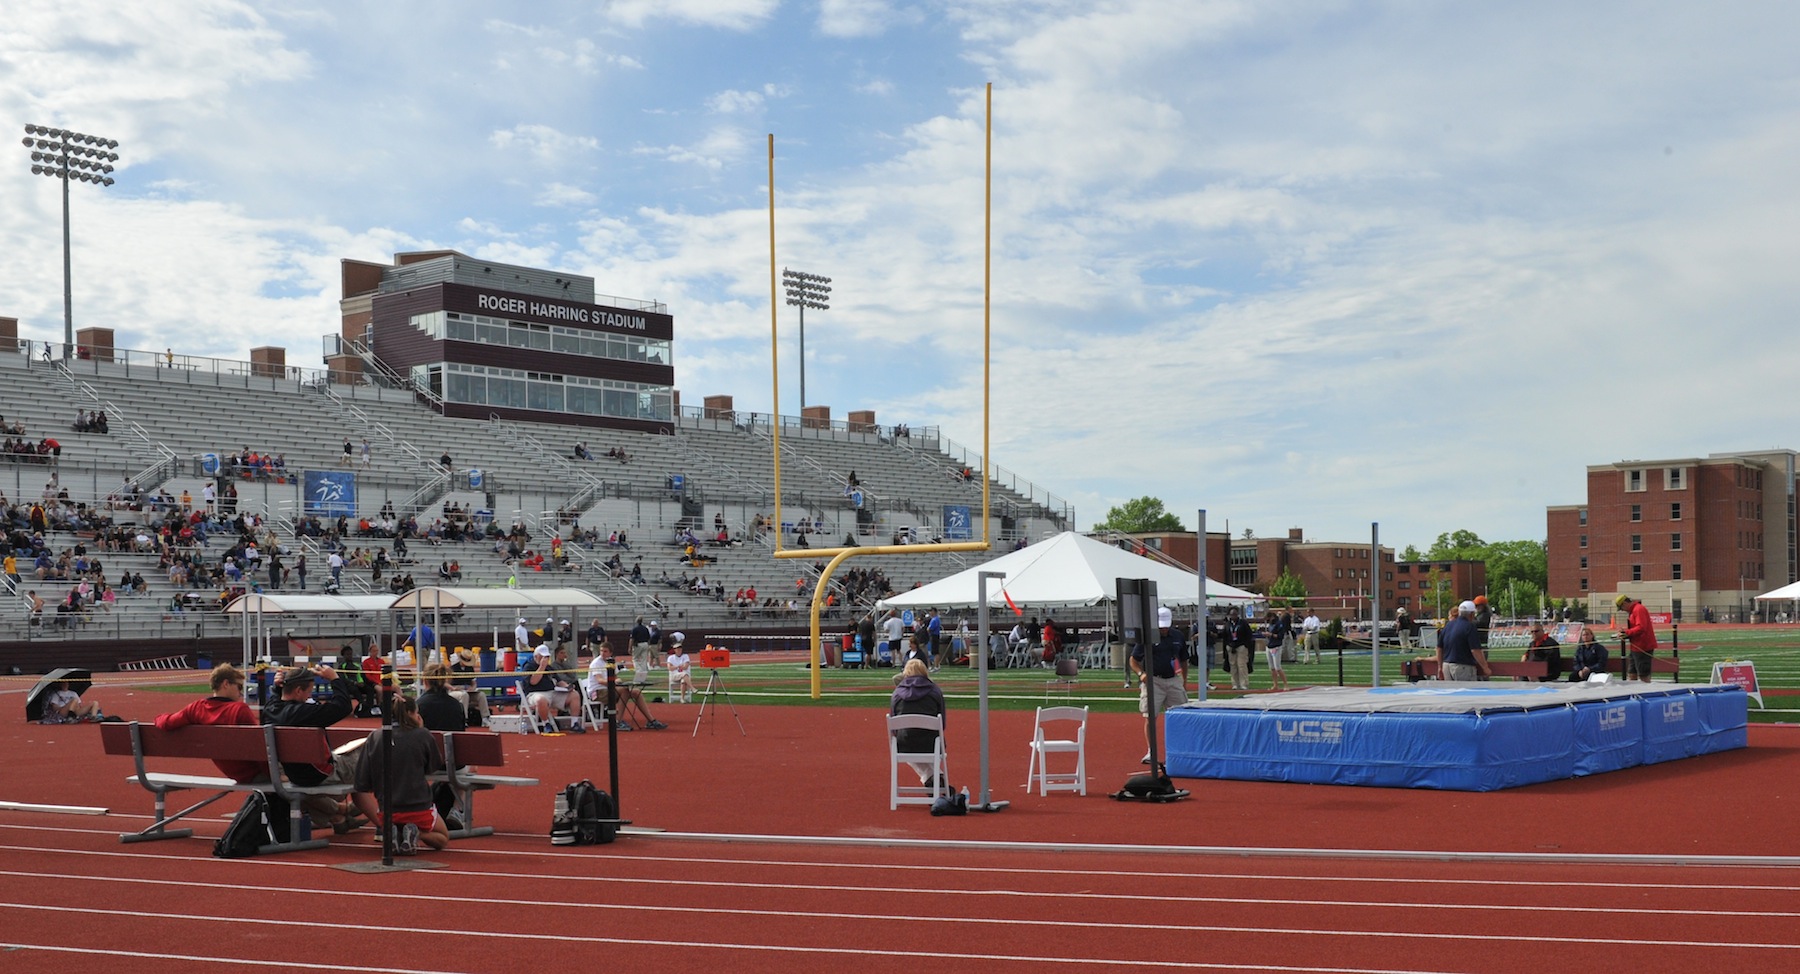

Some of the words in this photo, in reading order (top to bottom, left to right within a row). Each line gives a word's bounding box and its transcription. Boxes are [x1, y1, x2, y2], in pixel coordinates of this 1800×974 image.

[478, 294, 526, 314] ROGER
[530, 302, 588, 323] HARRING
[591, 310, 646, 330] STADIUM
[1599, 706, 1626, 725] UCS
[1663, 701, 1685, 717] UCS
[1276, 720, 1343, 738] UCS
